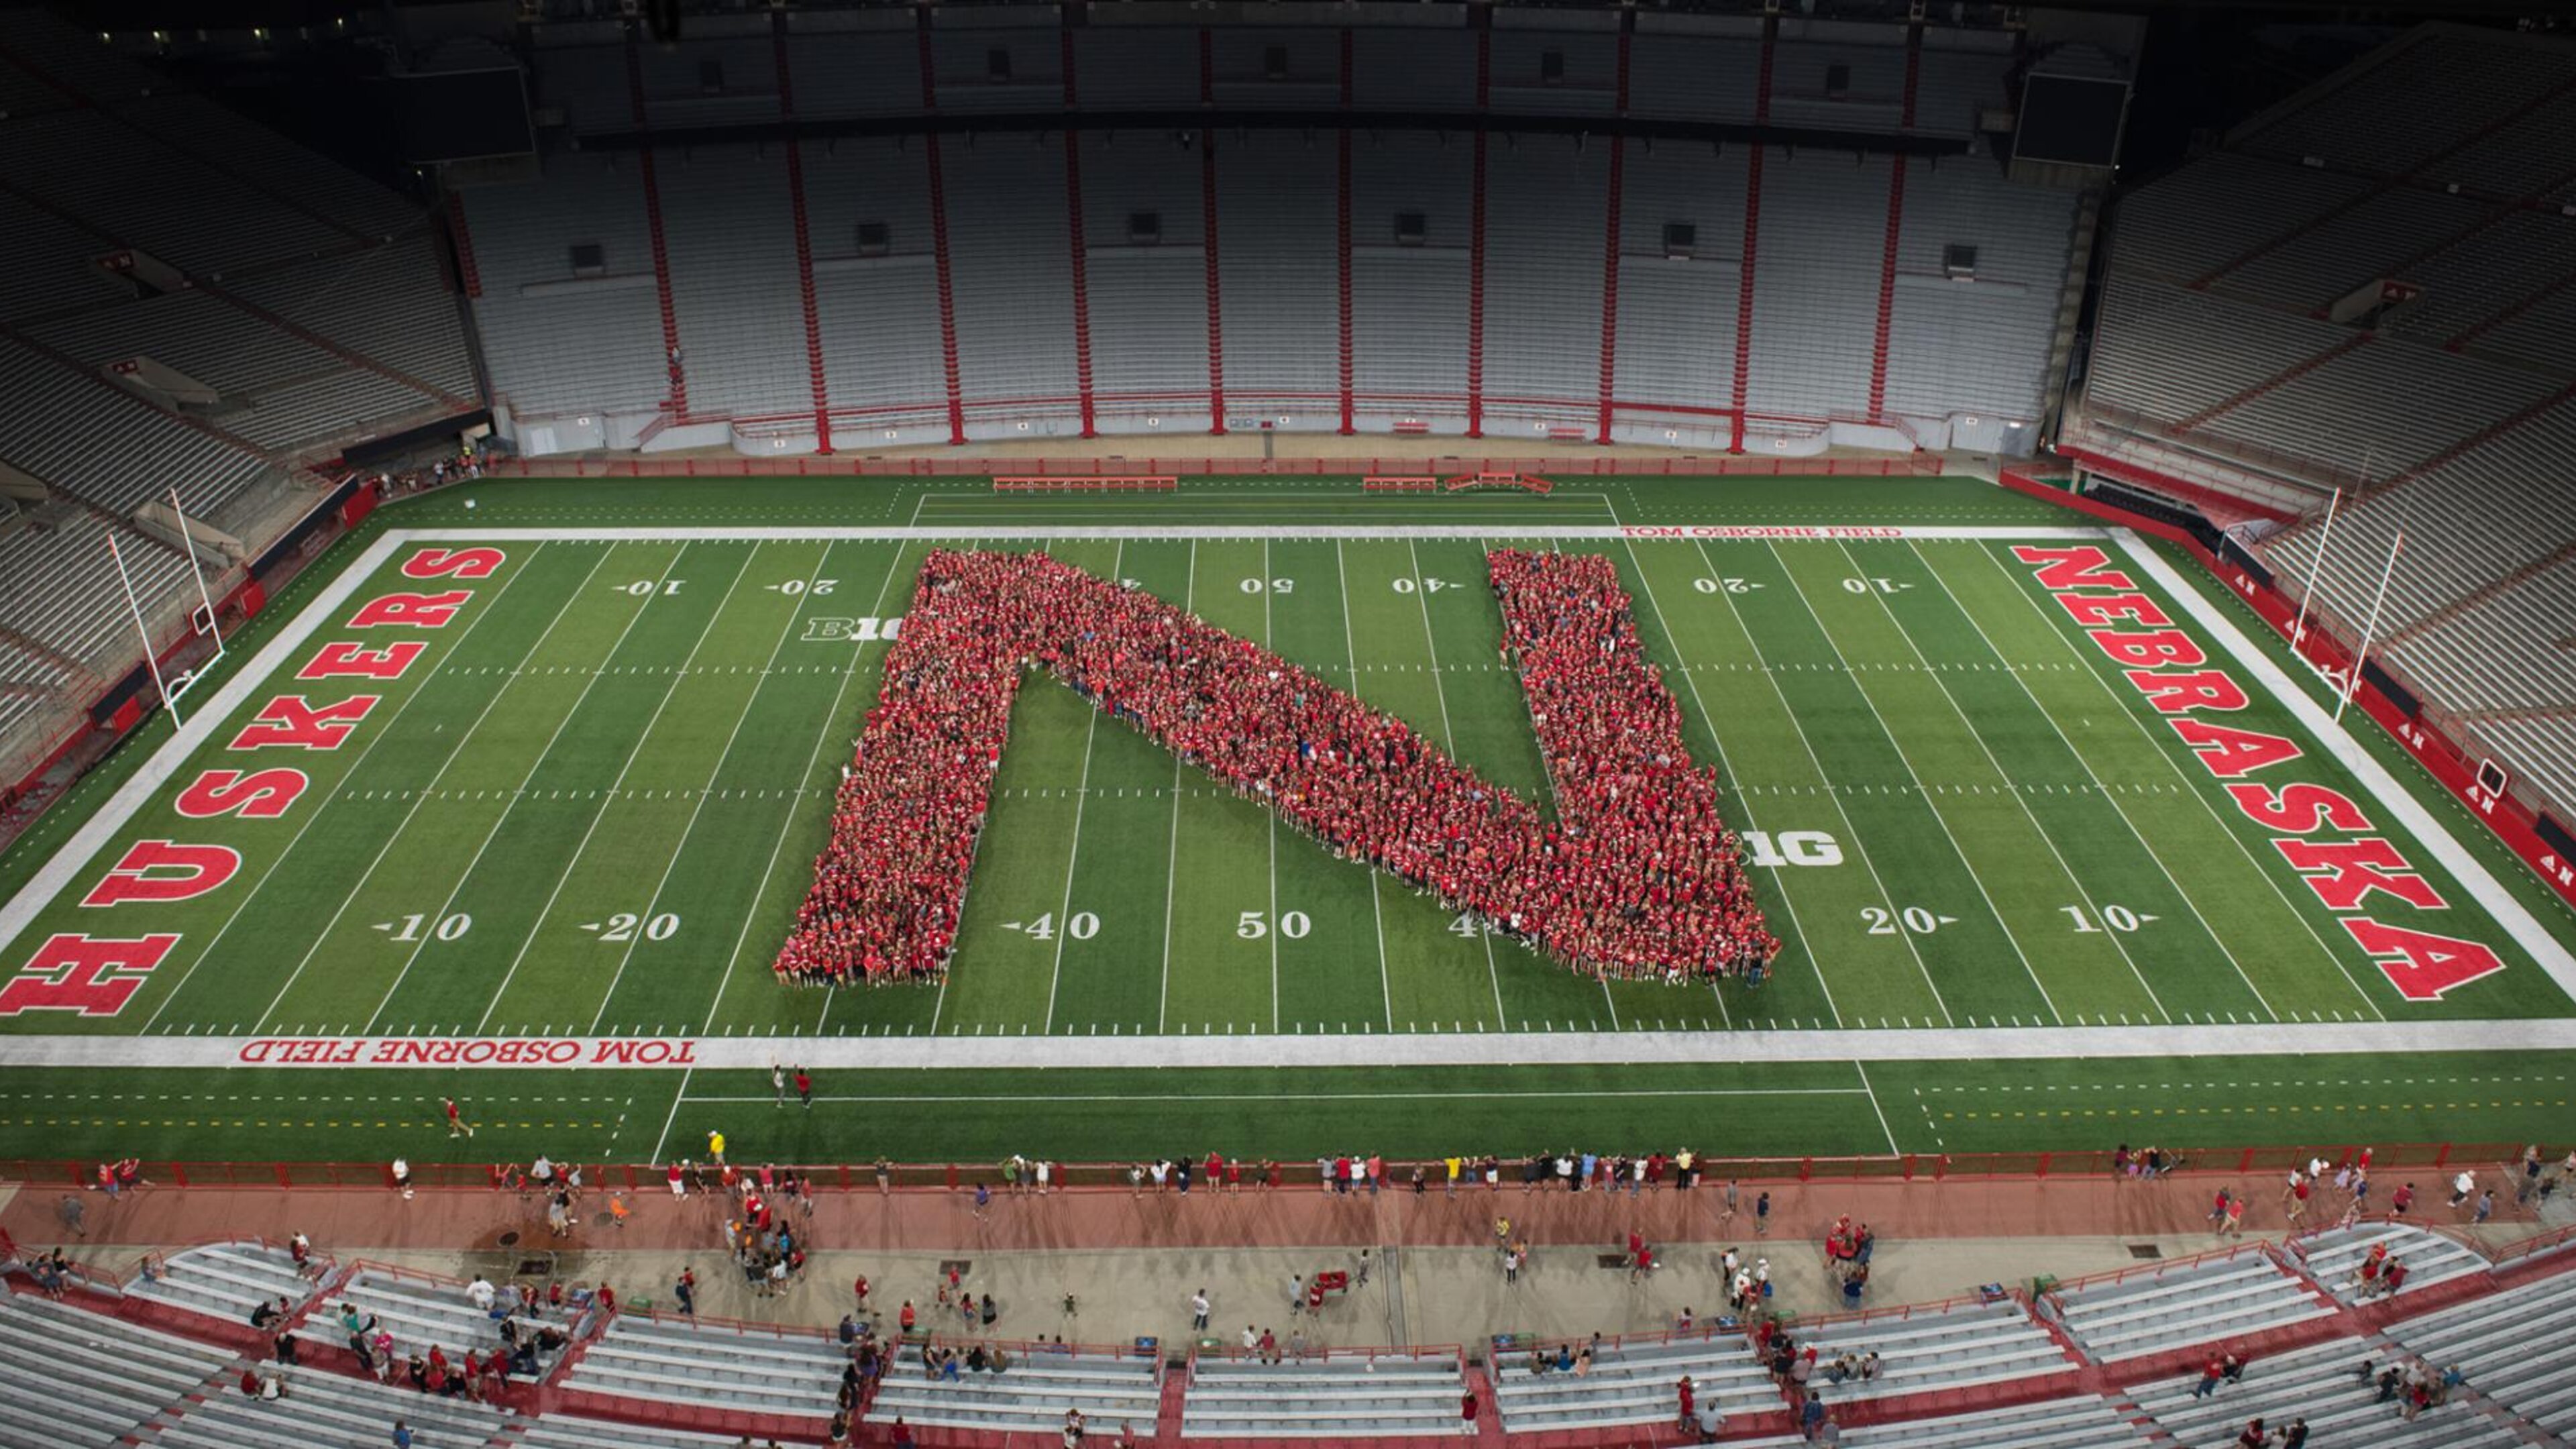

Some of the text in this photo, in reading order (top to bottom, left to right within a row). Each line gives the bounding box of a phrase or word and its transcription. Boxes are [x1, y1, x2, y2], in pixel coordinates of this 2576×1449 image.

[1621, 527, 1903, 537] TOM OSBORNE FIELD
[627, 579, 687, 595] 10
[780, 579, 839, 594] 20
[1240, 578, 1294, 594] 50
[1392, 578, 1446, 593] 40
[1693, 578, 1749, 594] 20
[1842, 578, 1900, 594] 10
[0, 547, 506, 1017] HUSKERS
[2008, 545, 2508, 1001] NEBRASKA
[1740, 830, 1843, 866] 1G
[390, 913, 472, 941] 10
[599, 913, 680, 941] 20
[1024, 911, 1101, 939] 40
[1237, 911, 1311, 938] 50
[1860, 906, 1937, 934] 20
[2059, 904, 2139, 932] 10
[238, 1040, 696, 1063] TOM OSBORNE FIELD
